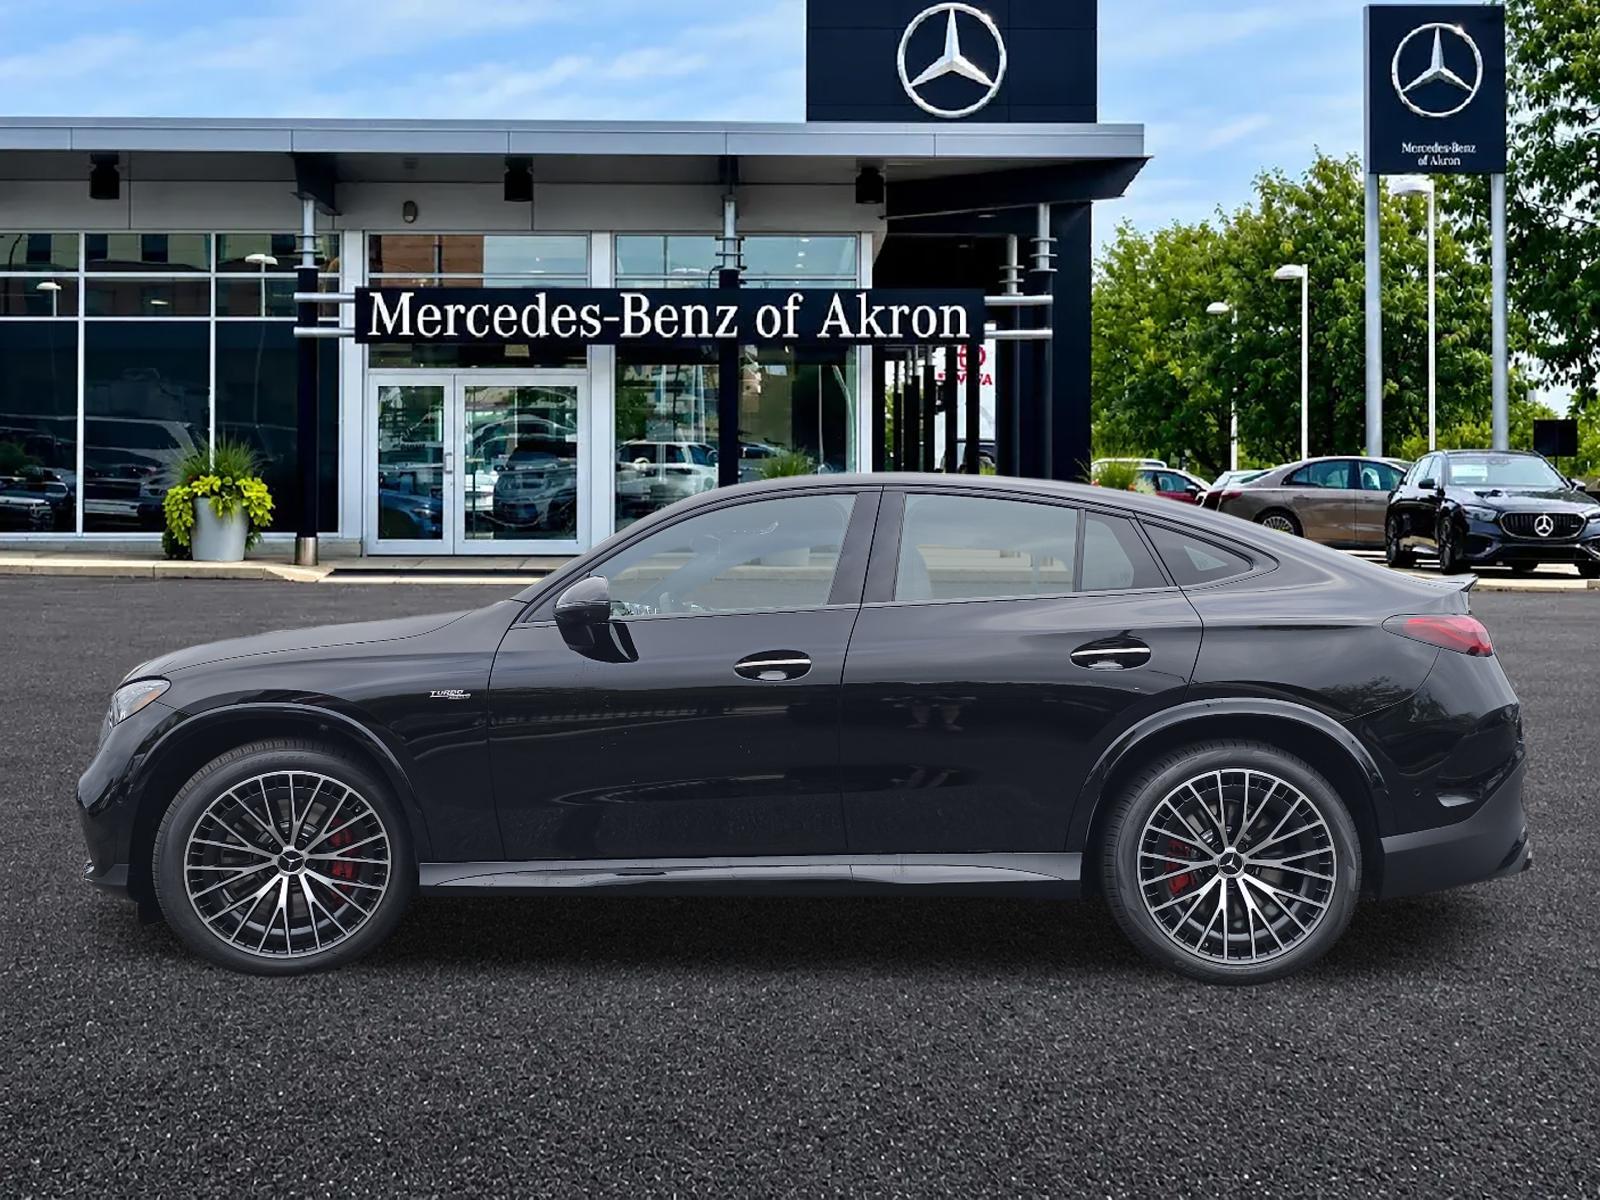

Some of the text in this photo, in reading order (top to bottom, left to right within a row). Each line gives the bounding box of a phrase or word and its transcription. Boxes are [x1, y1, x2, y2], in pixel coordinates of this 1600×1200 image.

[1401, 142, 1477, 154] Mercedes-Benz
[1417, 154, 1461, 166] of Akron
[367, 291, 971, 339] Mercedes-Benz of Akron
